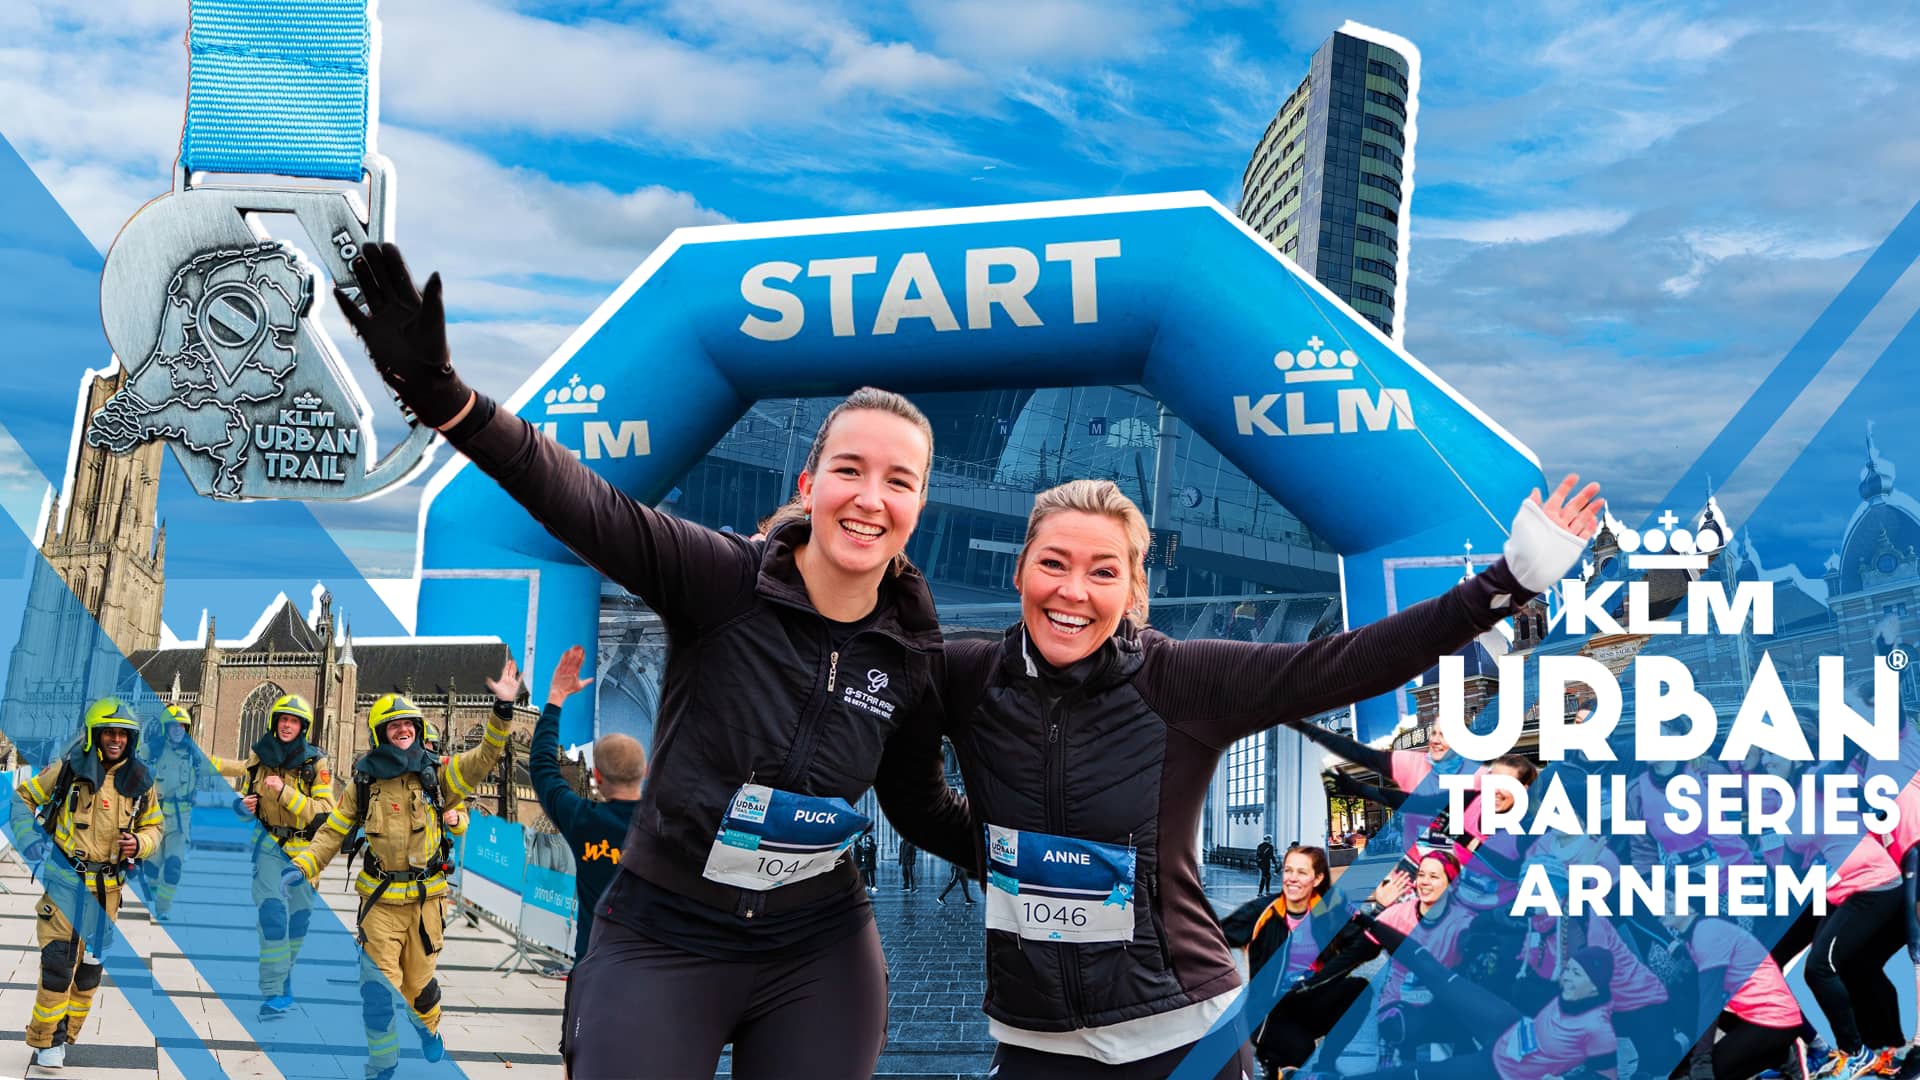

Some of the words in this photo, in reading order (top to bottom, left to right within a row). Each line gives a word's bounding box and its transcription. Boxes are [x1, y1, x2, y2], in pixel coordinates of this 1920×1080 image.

[739, 239, 1121, 341] START
[279, 410, 335, 428] KLM
[1233, 388, 1416, 436] KLM
[255, 425, 358, 454] URBAN
[531, 420, 651, 459] LM
[1000, 425, 1007, 435] N
[1091, 423, 1102, 435] M
[264, 453, 345, 481] TRAIL
[845, 687, 879, 706] G-STAR
[794, 810, 838, 825] PUCK
[1042, 849, 1091, 865] ANNE
[1023, 901, 1087, 927] 1046
